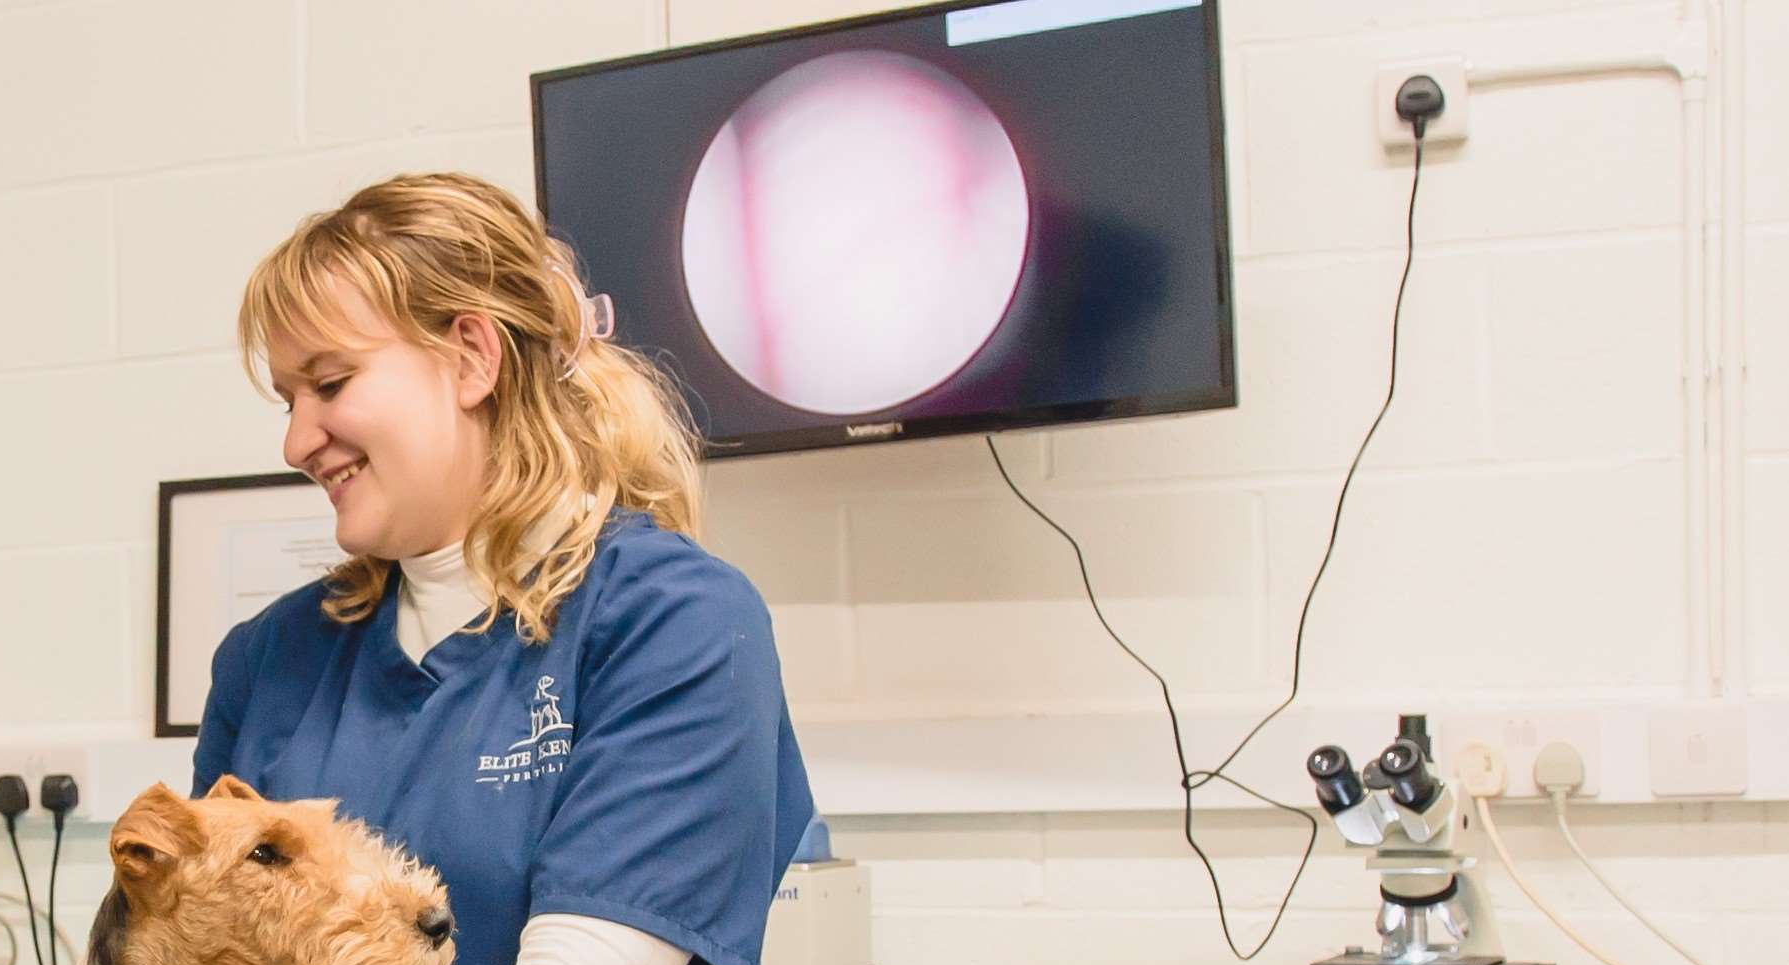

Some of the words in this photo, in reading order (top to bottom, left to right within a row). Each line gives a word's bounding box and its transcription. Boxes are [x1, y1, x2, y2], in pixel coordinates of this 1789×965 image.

[477, 751, 532, 771] ELITE
[538, 739, 572, 760] KEN
[503, 762, 564, 783] FERTILI
